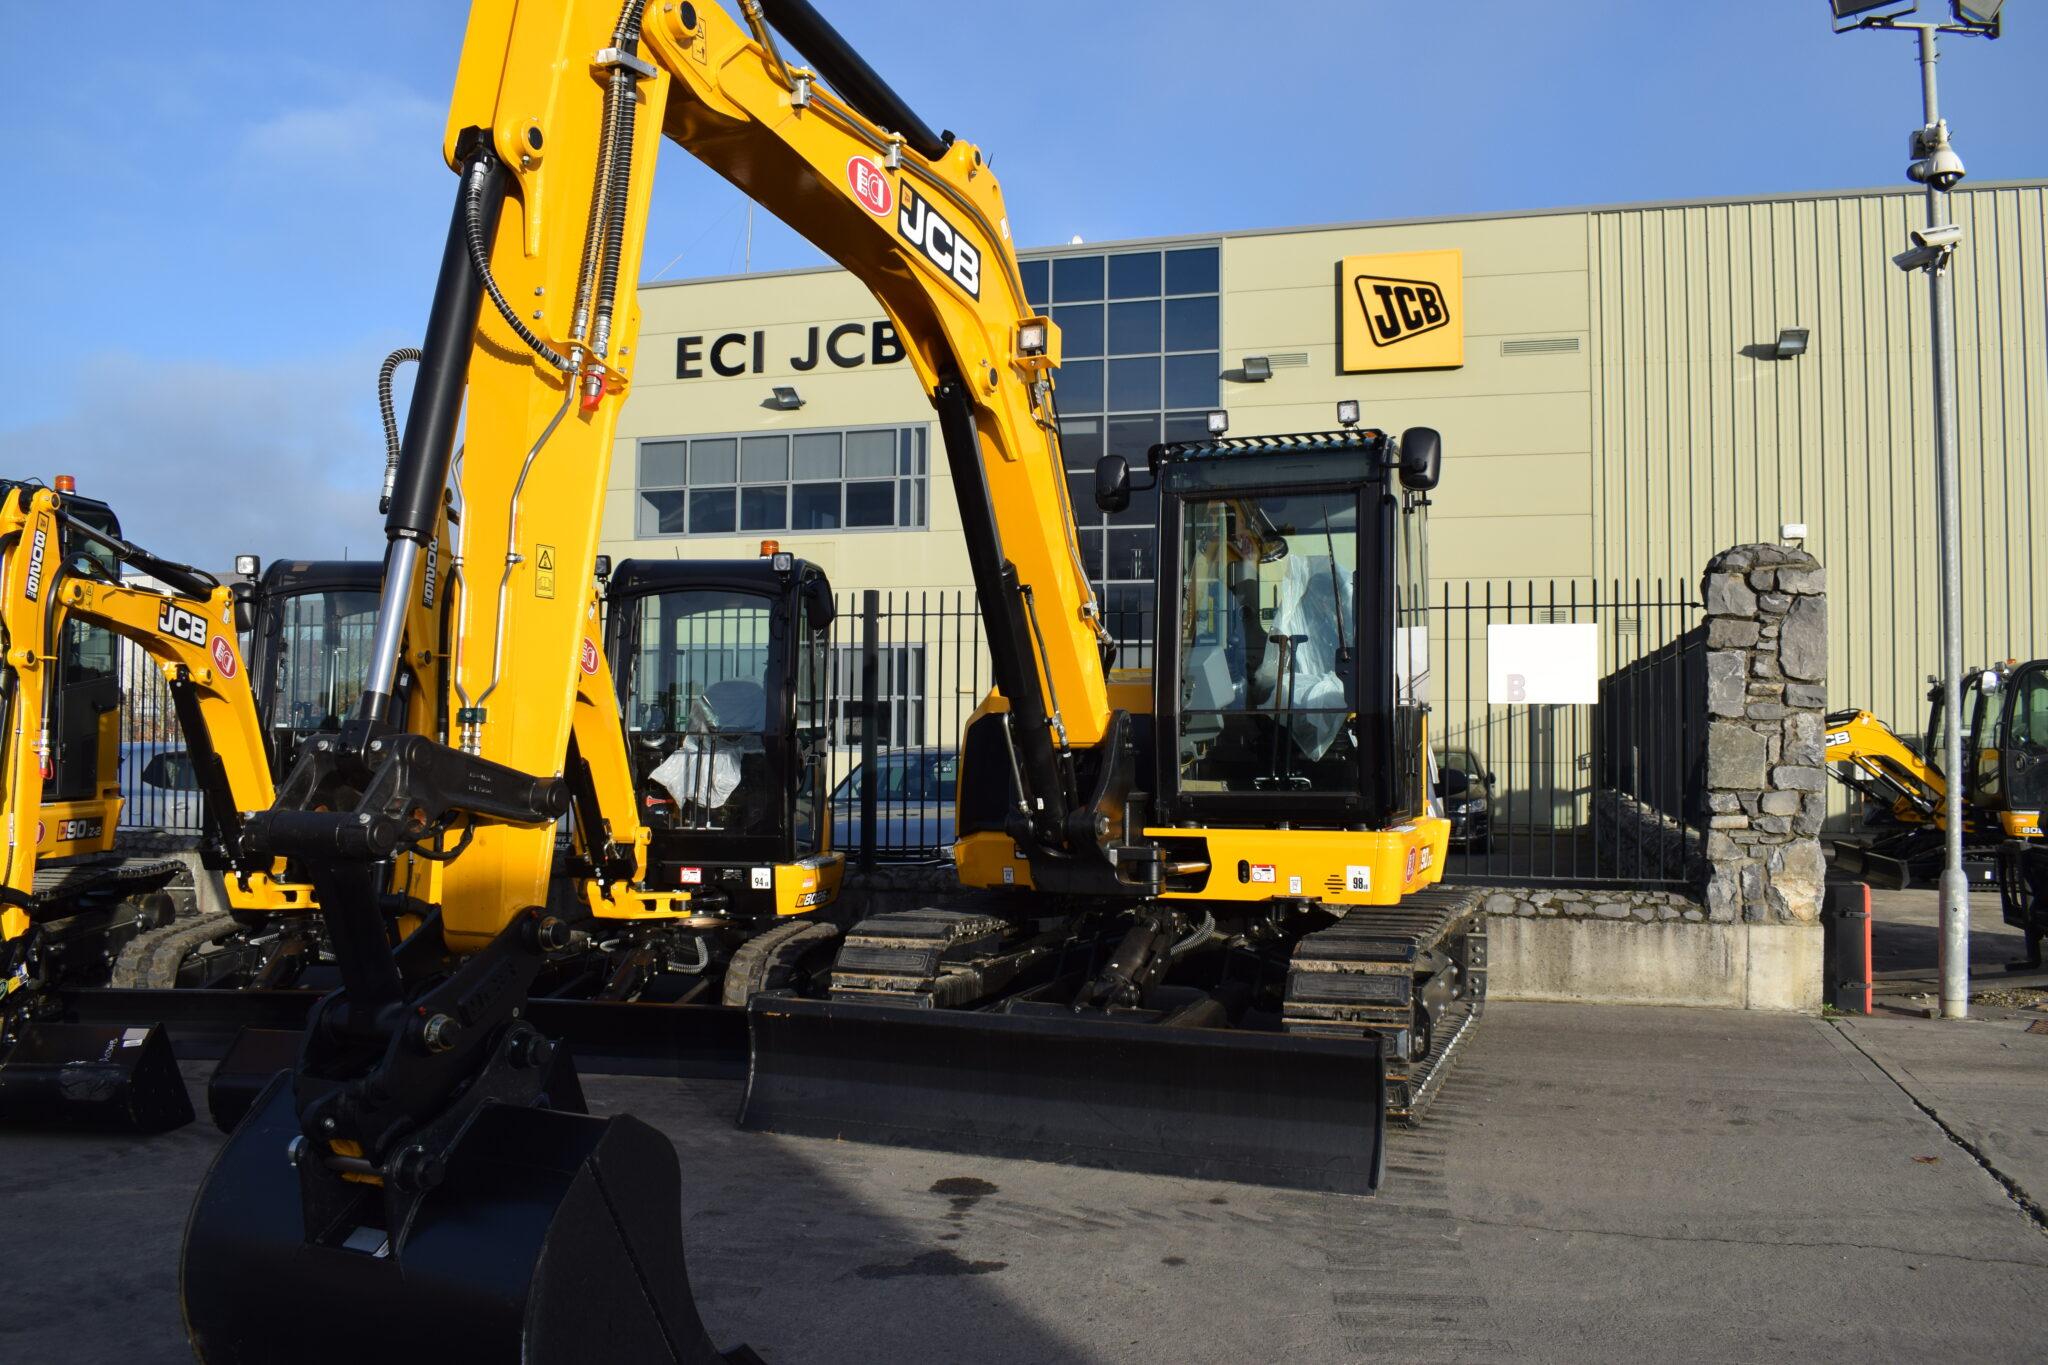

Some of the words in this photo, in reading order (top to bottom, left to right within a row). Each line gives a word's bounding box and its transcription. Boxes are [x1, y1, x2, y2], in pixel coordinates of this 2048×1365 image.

[857, 161, 884, 209] ECI
[900, 198, 979, 295] JCB
[1372, 284, 1442, 339] JCB
[676, 330, 765, 379] ECI
[790, 320, 907, 371] JCB
[27, 530, 46, 597] 8026
[159, 605, 207, 645] JCB
[1506, 673, 1526, 701] B
[1824, 731, 1850, 746] CB
[66, 820, 87, 840] 90
[754, 877, 764, 887] 94
[1353, 877, 1364, 889] 98
